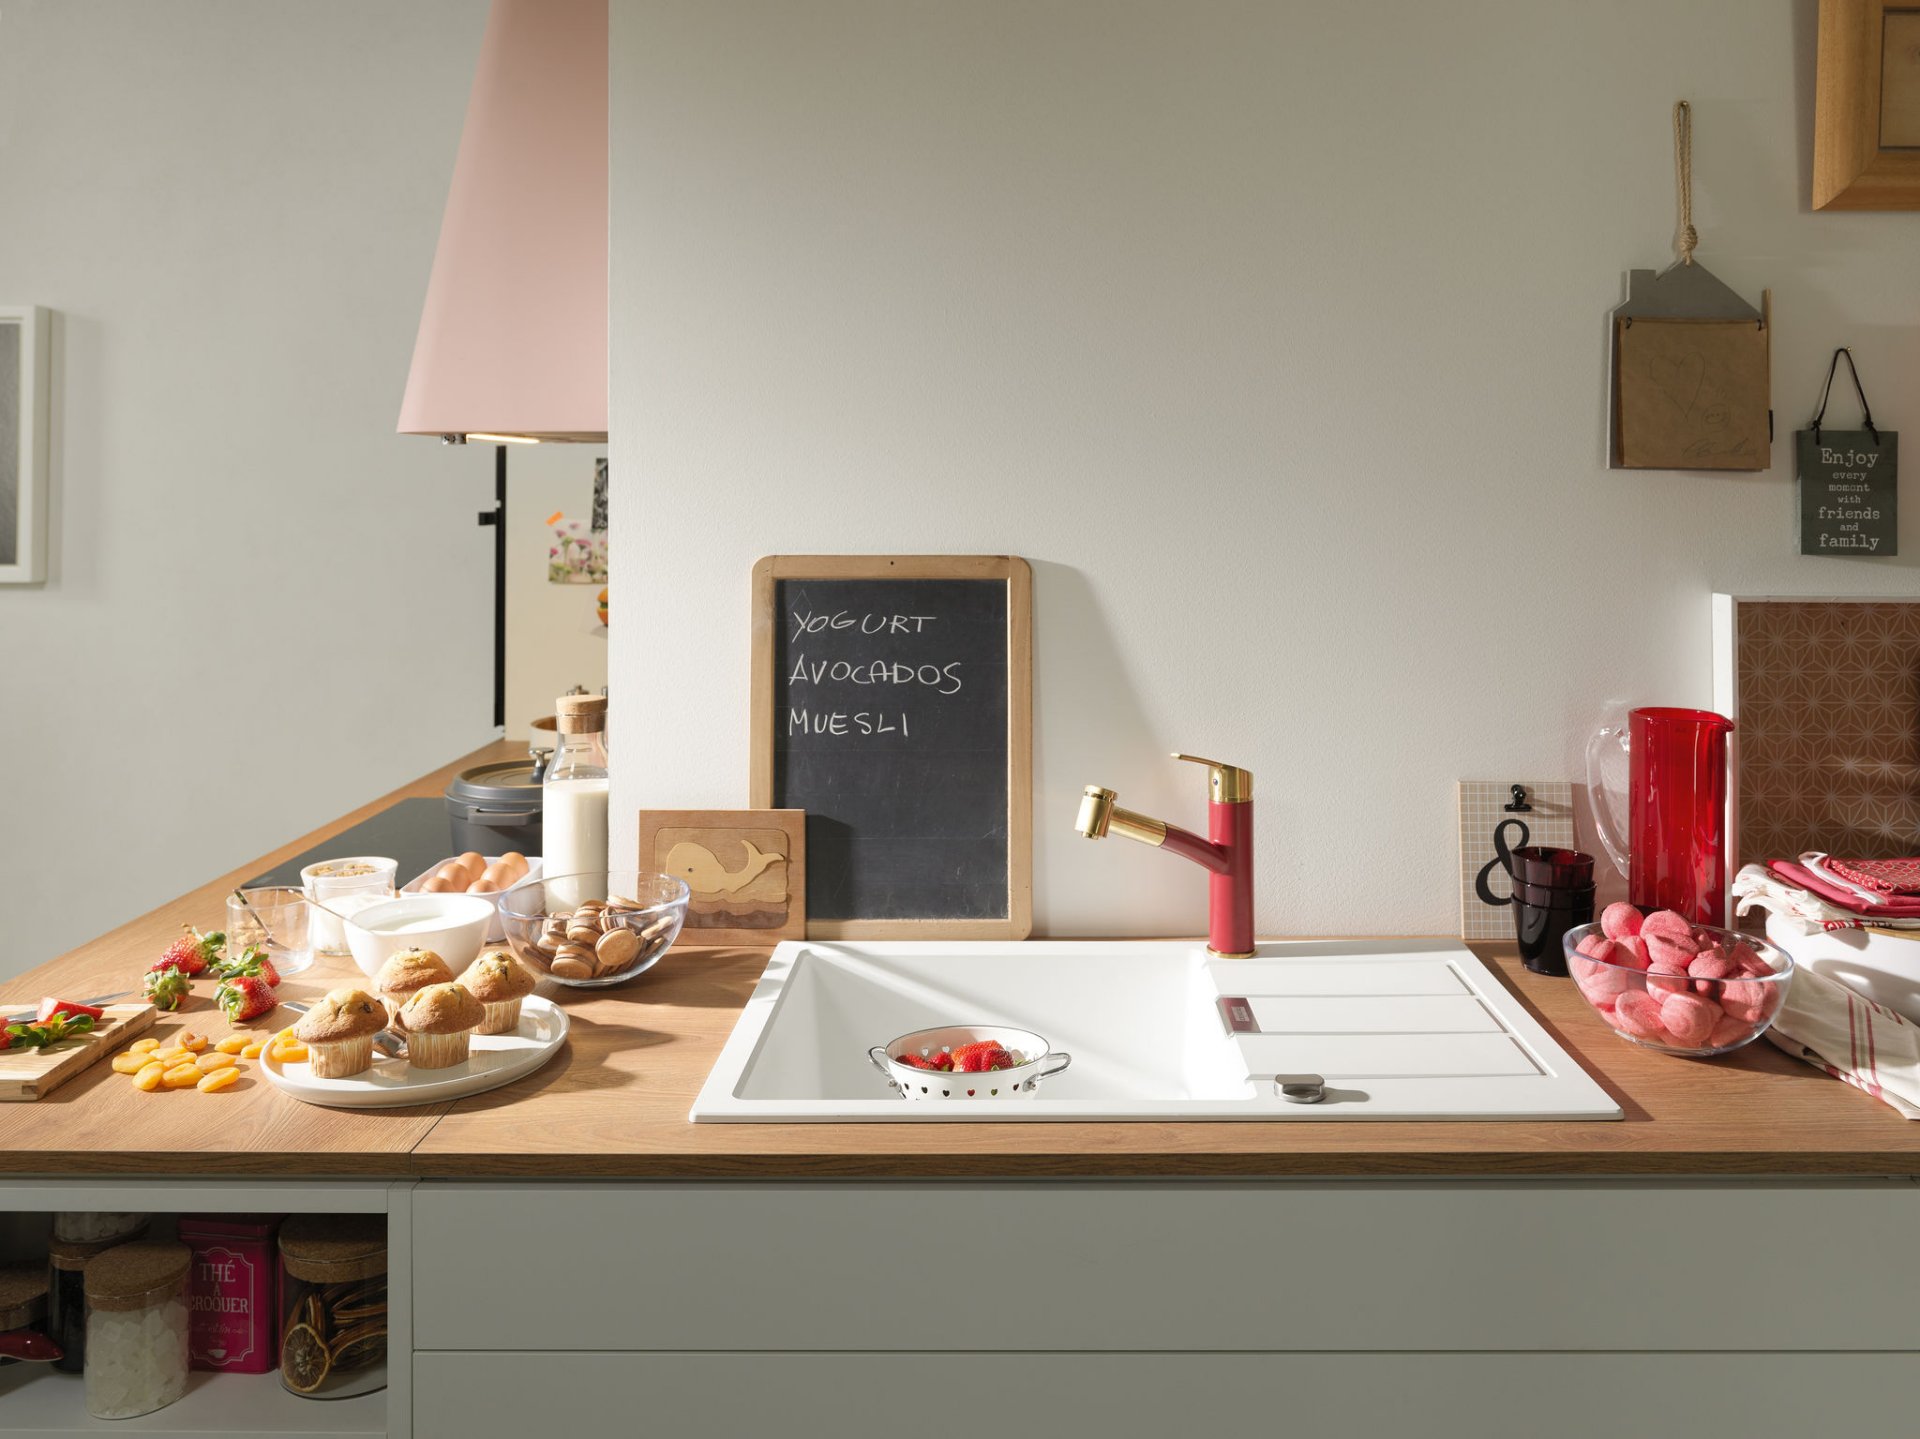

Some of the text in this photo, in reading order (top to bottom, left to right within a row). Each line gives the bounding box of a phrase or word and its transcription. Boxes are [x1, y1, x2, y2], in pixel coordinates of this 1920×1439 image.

[1820, 448, 1879, 468] Enjoy
[1832, 471, 1867, 480] every
[1828, 483, 1871, 492] moment
[1838, 495, 1861, 504] with
[1818, 507, 1881, 519] friends
[1840, 523, 1859, 532] and
[1819, 534, 1880, 551] family
[791, 610, 938, 643] YOGURT
[788, 653, 962, 695] AVOCADOS
[788, 707, 909, 737] MUESLI
[198, 1259, 236, 1283] THÉ
